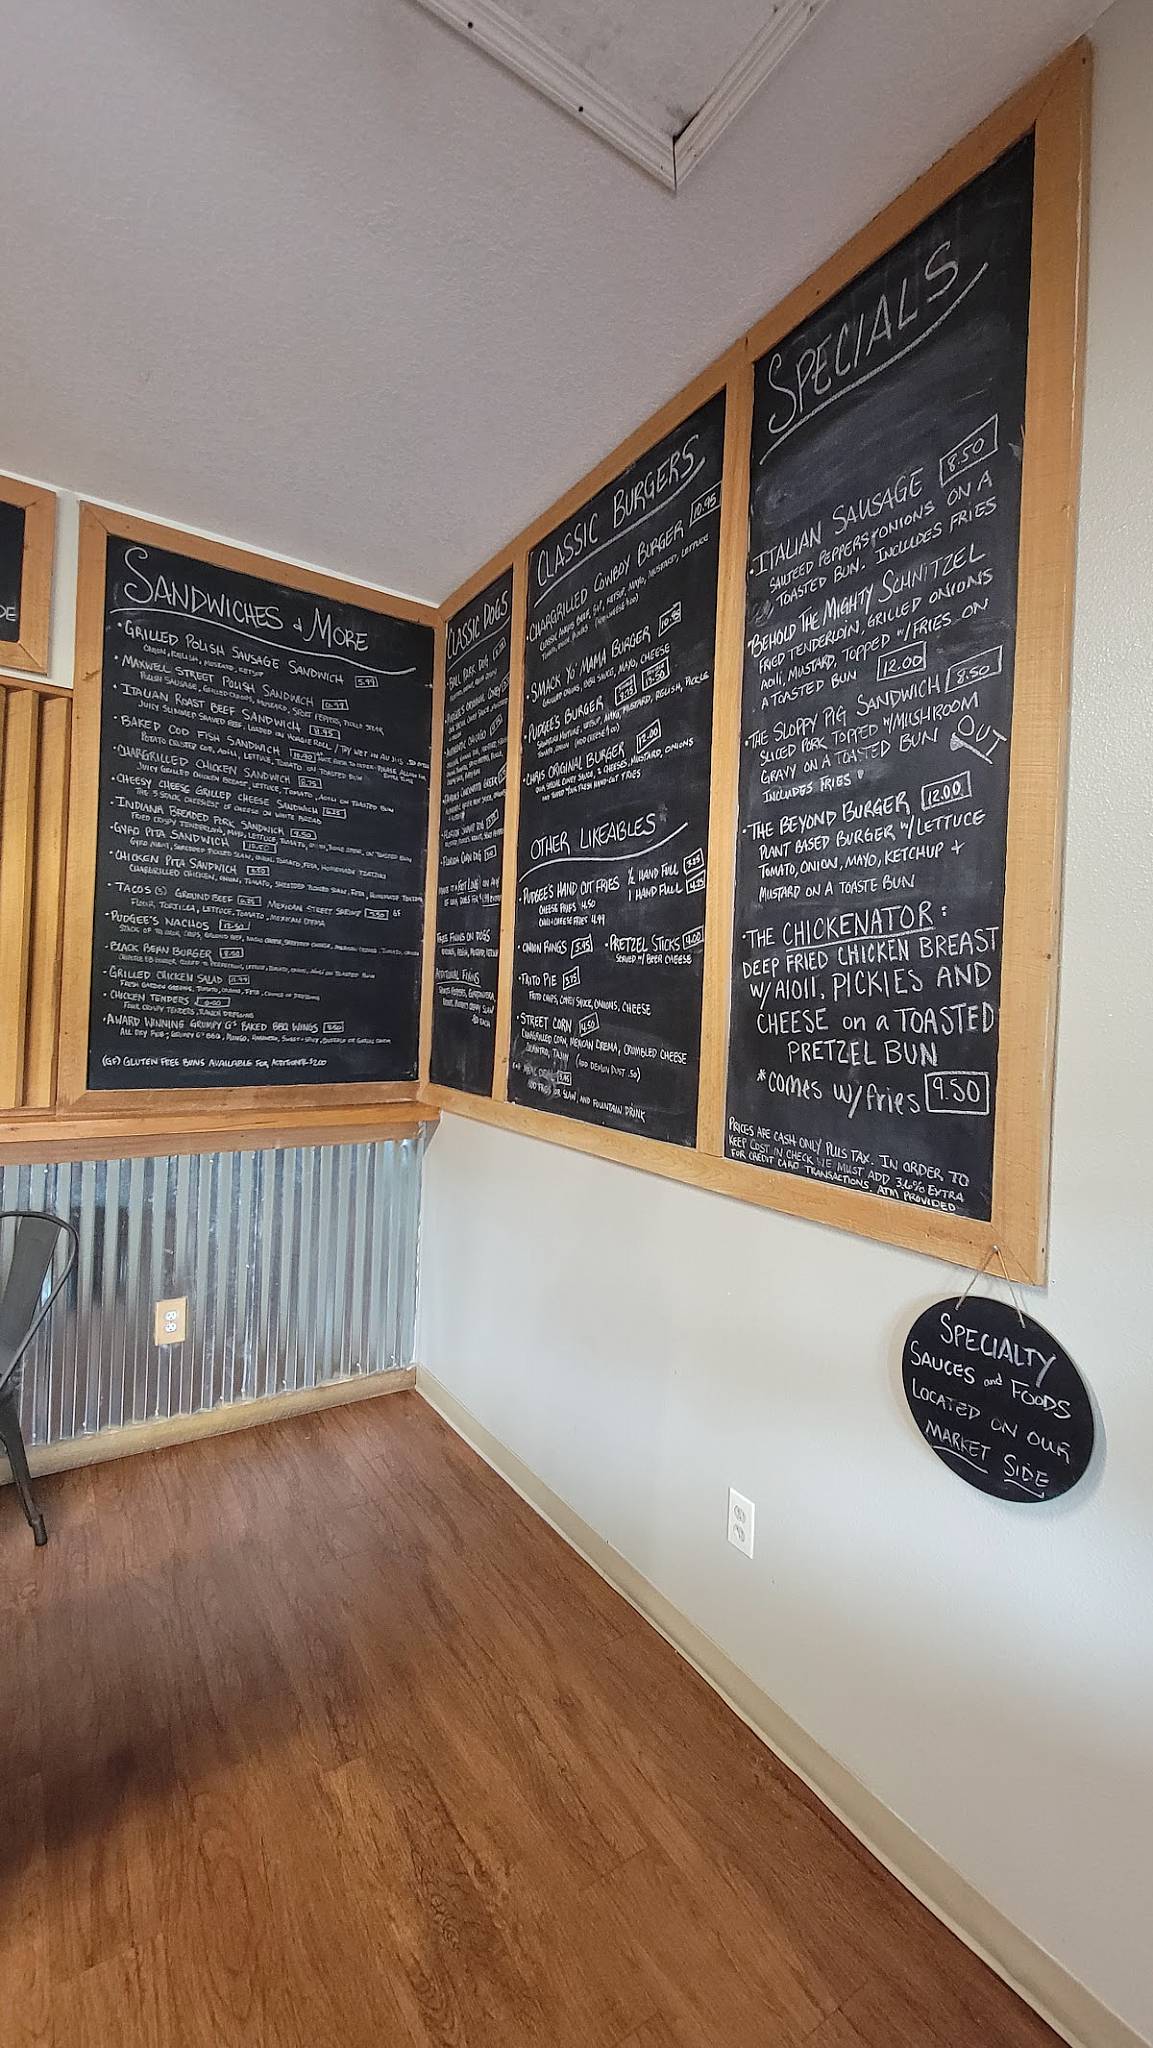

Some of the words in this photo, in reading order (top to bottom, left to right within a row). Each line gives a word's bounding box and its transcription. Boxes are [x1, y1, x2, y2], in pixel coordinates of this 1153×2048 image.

[768, 241, 958, 434] SPECIALS
[948, 482, 970, 506] ON
[978, 470, 992, 490] A
[537, 513, 598, 587] CLASSIC
[613, 434, 698, 529] BURGERS
[752, 521, 822, 576] ITALIAN
[832, 468, 924, 534] SAUSAGE
[946, 438, 984, 470] 8.50
[776, 577, 826, 606] TOASTED
[876, 522, 942, 564] INCLUDES
[950, 497, 997, 533] FRIES
[529, 588, 587, 642] CHARGRILLED
[594, 554, 630, 592] COWBOY
[638, 520, 684, 567] BURGER
[124, 547, 283, 630] SANDWICHES
[303, 608, 369, 651] MORE
[823, 583, 873, 624] MIGHTY
[868, 598, 921, 628] GRILLED
[961, 598, 989, 618] ON
[448, 615, 480, 659] CLASSIC
[484, 590, 508, 630] DOGS
[125, 620, 178, 646] GRILLED
[186, 634, 224, 655] POLISH
[232, 646, 280, 669] SAUSAGE
[288, 660, 344, 684] SANDWICH
[531, 674, 562, 703] SMACK
[580, 648, 606, 676] MAMA
[611, 626, 651, 658] BURGER
[640, 642, 670, 664] CHEESE
[122, 655, 171, 673] MAXWELL
[175, 667, 214, 682] STREET
[222, 676, 255, 693] POLISH
[263, 684, 314, 707] SANDWICH
[832, 671, 857, 689] BUN
[882, 654, 921, 674] 12.00
[121, 683, 168, 702] ITALIAN
[175, 693, 205, 708] ROAST
[211, 703, 235, 714] BEEF
[242, 709, 301, 733] SANDWICH
[565, 696, 604, 725] BURGER
[774, 715, 818, 742] SLOPPY
[823, 707, 847, 726] PIG
[857, 674, 940, 716] SANDWICH
[956, 665, 990, 684] 8.50
[121, 715, 160, 731] BAKED
[168, 725, 189, 736] COD
[198, 731, 220, 742] FISH
[227, 736, 280, 755] SANDWICH
[665, 737, 694, 753] ONIONS
[760, 744, 796, 766] SLICED
[801, 739, 827, 753] PORK
[832, 724, 878, 744] TOPPED
[196, 759, 237, 775] CHICKEN
[243, 767, 291, 784] SANDWICH
[526, 770, 545, 786] CHRIS
[548, 753, 582, 778] ORIGINAL
[586, 741, 625, 769] BURGER
[760, 764, 796, 785] GRAVY
[804, 759, 817, 772] ON
[900, 728, 938, 752] BUN
[116, 773, 152, 788] CHEESY
[159, 780, 190, 794] CHEESE
[195, 786, 231, 800] GRILLED
[238, 793, 269, 806] CHEESE
[277, 800, 318, 814] SANDWICH
[762, 782, 813, 803] INCLUDES
[820, 773, 851, 788] FRIES
[115, 796, 164, 815] INDIANA
[169, 806, 209, 822] BREADED
[214, 816, 235, 828] PORK
[240, 820, 285, 836] SANDWICH
[748, 820, 773, 840] THE
[780, 811, 836, 835] BEYOND
[842, 791, 910, 823] BURGER
[114, 822, 139, 836] GYRO
[170, 830, 230, 846] SANDWICH
[531, 831, 570, 860] OTHER
[580, 813, 656, 849] LIKEABLES
[759, 842, 791, 860] PLANT
[795, 836, 829, 853] BASED
[836, 823, 895, 847] BURGER
[115, 850, 159, 863] CHICKEN
[189, 858, 237, 875] SANDWICH
[885, 843, 943, 864] KETCHUP
[557, 881, 577, 897] HAND
[580, 880, 592, 895] CUT
[596, 876, 619, 893] FRIES
[639, 867, 658, 881] HAND
[661, 862, 679, 876] FULL
[115, 882, 151, 894] TACOS
[175, 889, 210, 900] GROUND
[212, 894, 233, 903] BEEF
[636, 885, 657, 900] HAND
[659, 882, 683, 897] FULL
[759, 885, 800, 902] MUSTARD
[806, 883, 821, 896] ON
[883, 874, 914, 890] BUN
[165, 918, 209, 931] NACHOS
[746, 928, 776, 948] THE
[172, 948, 212, 962] BURGER
[523, 943, 542, 954] ONION
[544, 940, 567, 952] RINGS
[609, 934, 648, 952] PRETZEL
[651, 934, 680, 952] STICKS
[743, 958, 779, 978] DEEP
[786, 951, 828, 973] FRIED
[838, 939, 909, 966] CHICKEN
[920, 927, 999, 959] BREAST
[109, 966, 150, 979] GRILLED
[665, 953, 692, 964] CHEESE
[543, 973, 557, 987] PIE
[937, 962, 991, 988] AND
[107, 1014, 140, 1025] AWARD
[145, 1017, 184, 1029] WINNING
[520, 1012, 548, 1028] STREET
[552, 1015, 572, 1033] CORN
[622, 1001, 651, 1015] CHEESE
[757, 1008, 828, 1036] CHEESE
[843, 1015, 866, 1031] on
[893, 1002, 994, 1035] TOASTED
[123, 1056, 158, 1066] GLUTEN
[161, 1058, 179, 1066] FREE
[660, 1049, 687, 1064] CHEESE
[788, 1039, 876, 1065] PRETZEL
[885, 1041, 938, 1067] BUN
[933, 1077, 981, 1102] 9.50
[625, 1105, 646, 1122] DRINK
[729, 1117, 754, 1137] PRICES
[774, 1131, 797, 1147] CASH
[800, 1138, 822, 1155] ONLY
[826, 1142, 847, 1158] PLUS
[879, 1154, 897, 1170] IN
[903, 1160, 944, 1181] ORDER
[948, 1171, 969, 1187] TO
[729, 1134, 747, 1149] KEEP
[749, 1139, 770, 1153] COST
[787, 1150, 813, 1165] CHECK
[837, 1161, 864, 1176] MUST
[867, 1169, 890, 1184] ADD
[878, 1185, 899, 1199] ATM
[940, 1313, 1056, 1388] SPECIALTY
[910, 1340, 975, 1384] SAUCES
[984, 1372, 1003, 1387] and
[1011, 1379, 1072, 1419] FOODS
[912, 1378, 980, 1420] LOCATED
[991, 1418, 1017, 1437] ON
[1027, 1431, 1071, 1464] OUR
[926, 1419, 991, 1461] MARKET
[1003, 1453, 1049, 1487] SIDE
